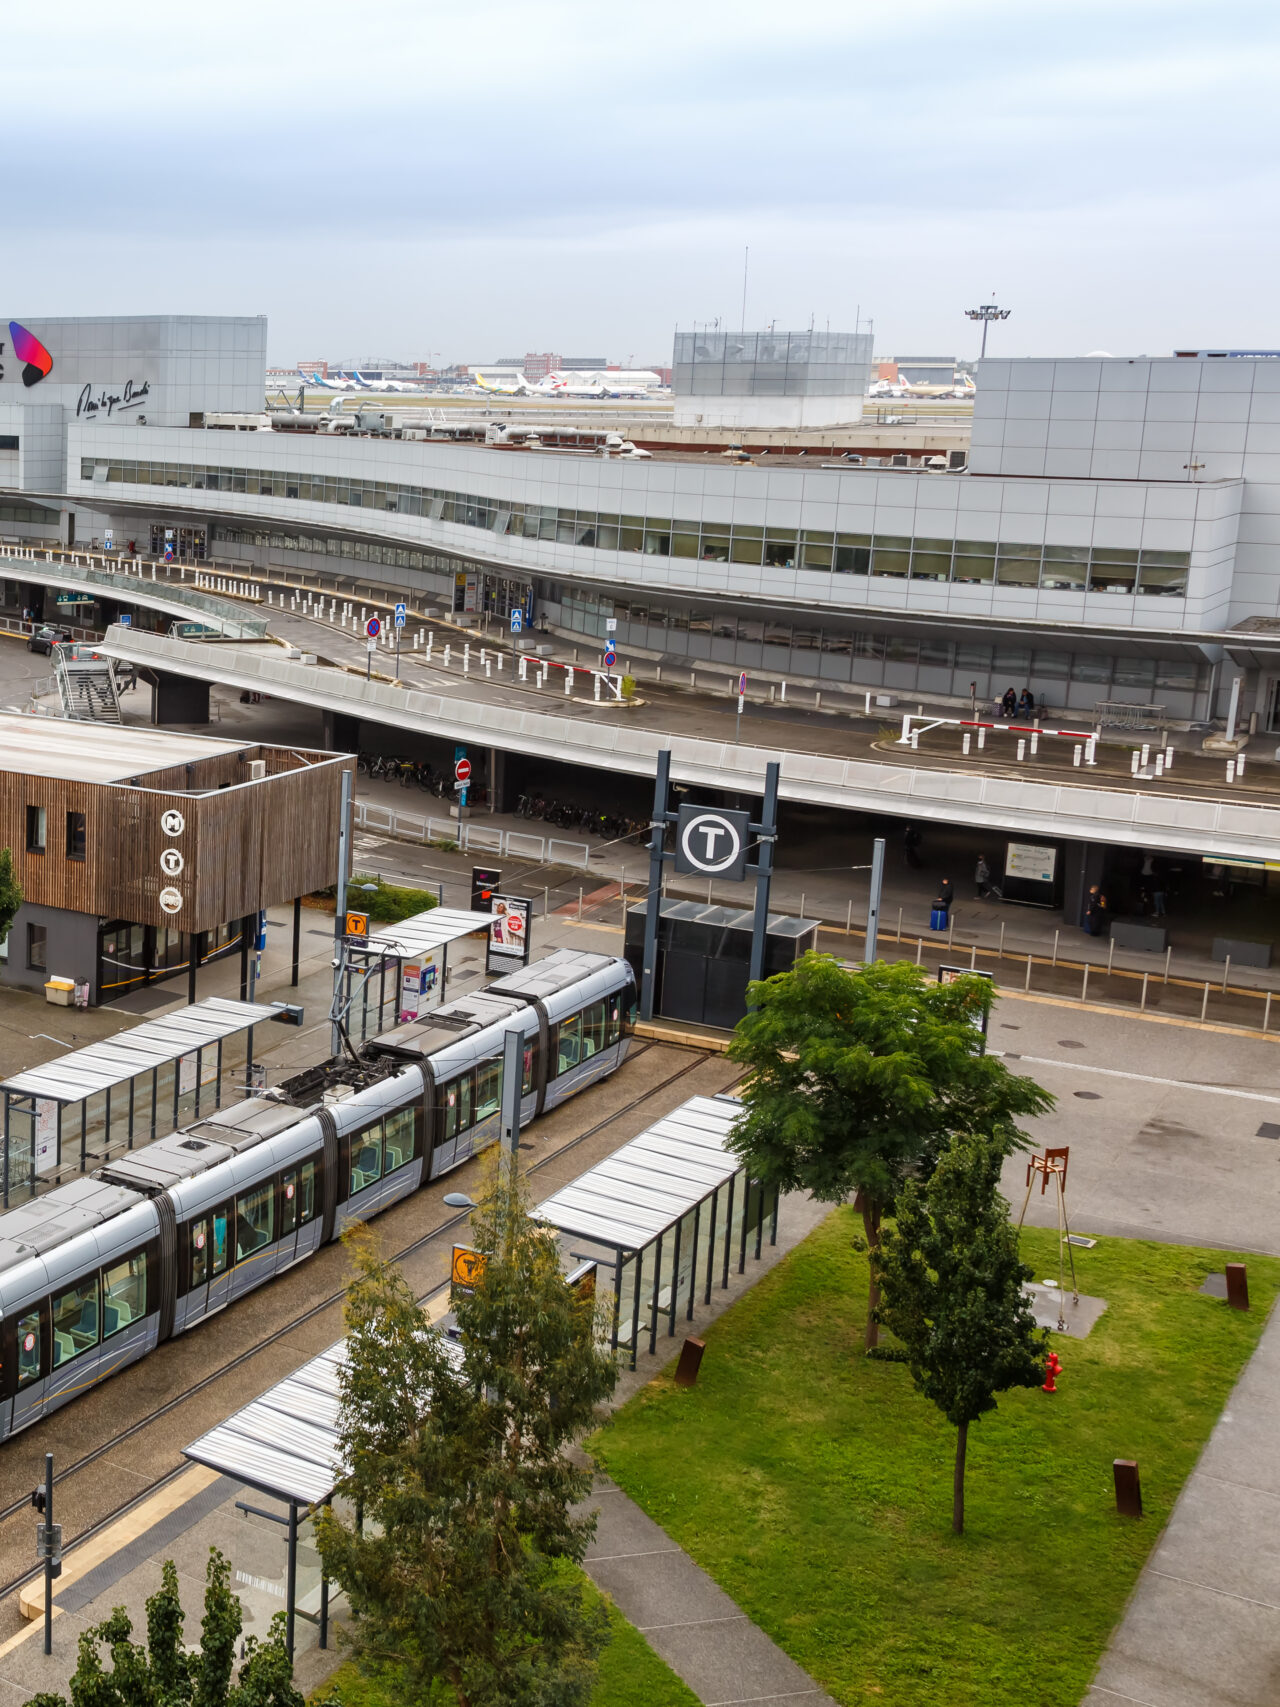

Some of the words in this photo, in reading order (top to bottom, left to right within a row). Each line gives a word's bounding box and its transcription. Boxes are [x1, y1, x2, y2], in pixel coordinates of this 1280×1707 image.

[166, 815, 180, 831] M
[698, 825, 725, 860] T
[166, 854, 178, 869] T
[352, 919, 361, 931] T
[463, 1258, 476, 1277] T
